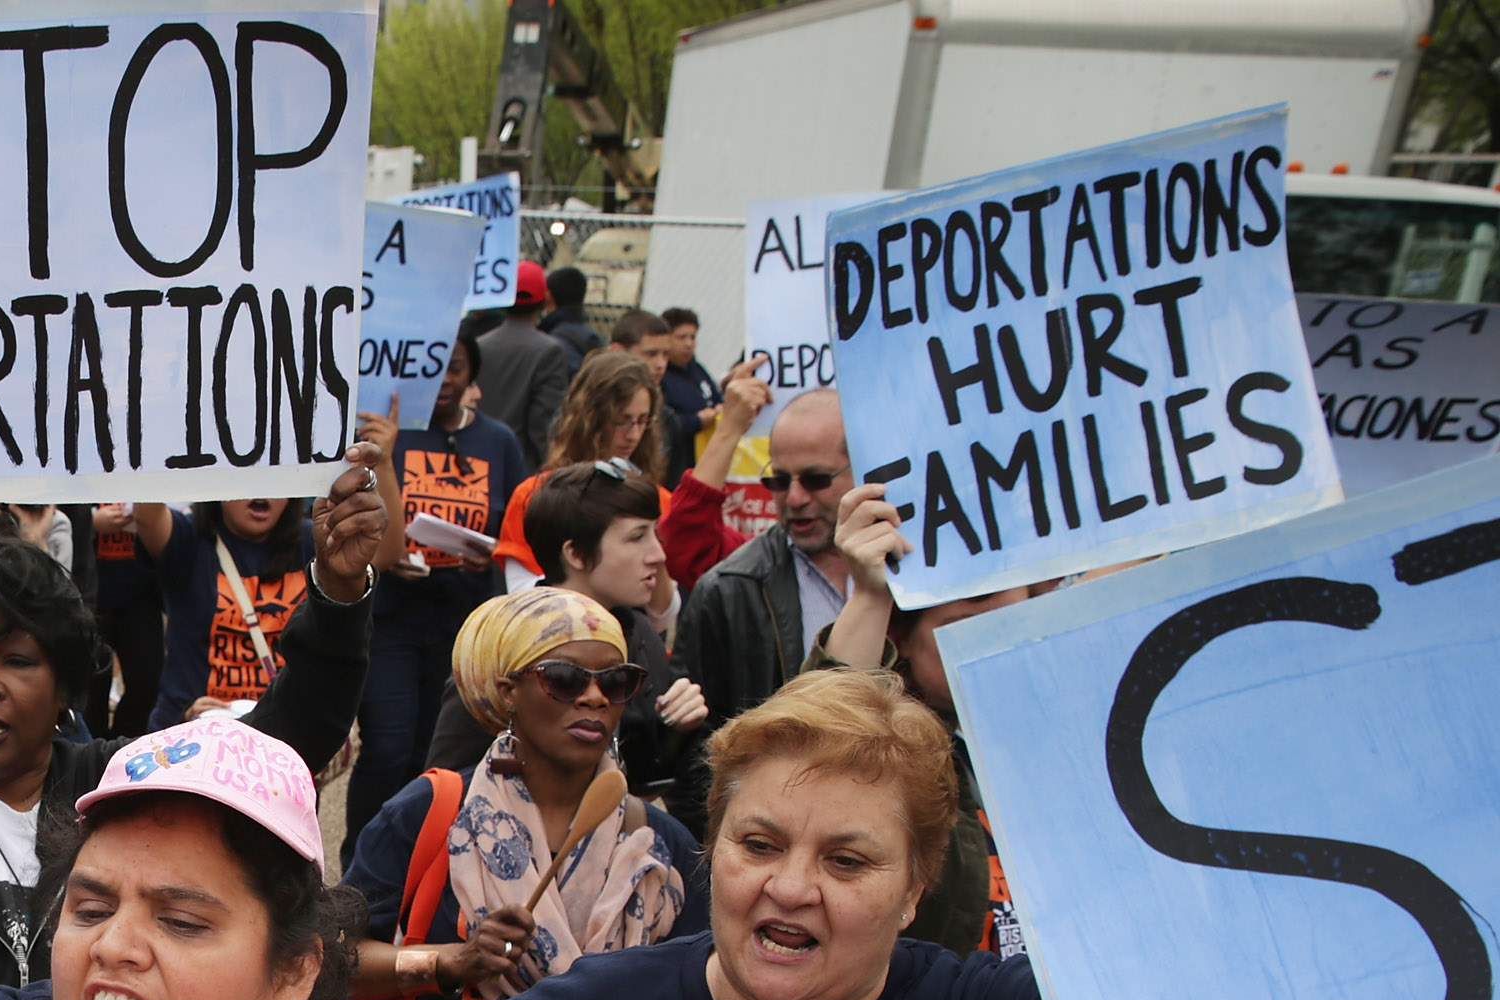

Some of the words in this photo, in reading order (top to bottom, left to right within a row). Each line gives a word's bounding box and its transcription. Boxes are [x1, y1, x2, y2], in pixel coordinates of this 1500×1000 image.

[375, 217, 406, 264] A
[834, 146, 1281, 341] DEPORTATIONS
[1430, 308, 1490, 335] A
[927, 276, 1203, 425] HURT
[1312, 333, 1424, 370] AS
[1317, 393, 1500, 442] ACIONES
[863, 371, 1303, 574] FAMILIES
[212, 766, 270, 803] USA
